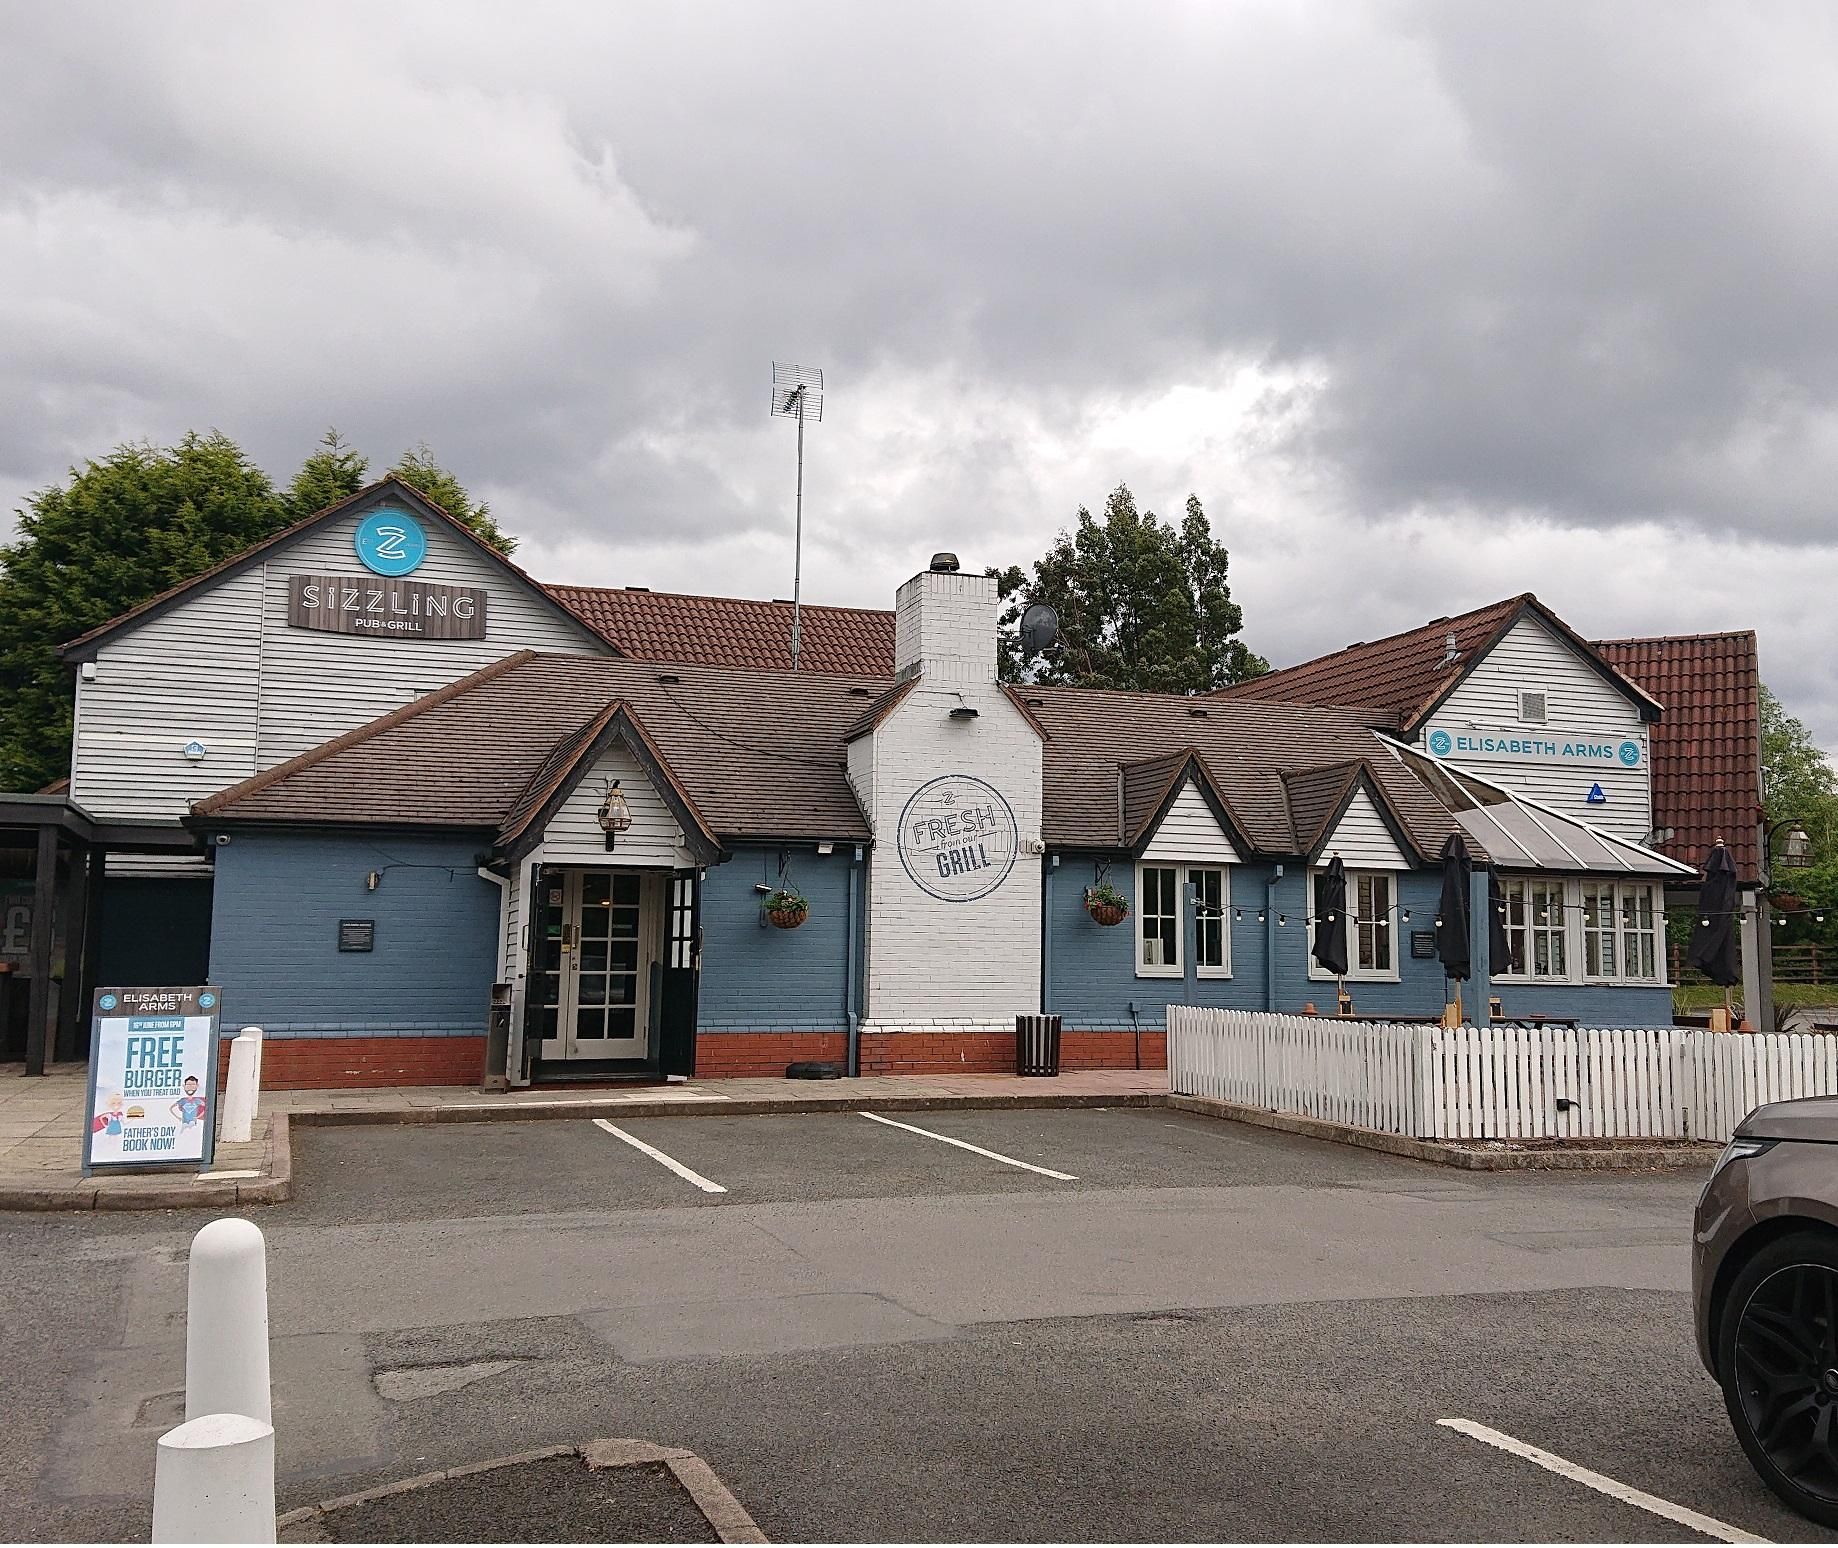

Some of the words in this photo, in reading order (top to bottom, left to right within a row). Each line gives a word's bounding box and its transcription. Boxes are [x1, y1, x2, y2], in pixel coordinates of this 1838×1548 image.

[1456, 737, 1556, 756] ELISABETH
[1562, 743, 1613, 759] ARMS
[912, 805, 996, 845] FRESH
[941, 839, 961, 850] from
[962, 834, 978, 844] our
[936, 843, 992, 878] GRILL
[123, 993, 193, 1003] ELISABETH
[138, 1002, 176, 1011] ARMS
[125, 1036, 185, 1069] FREE
[123, 1069, 182, 1089] BURGER
[123, 1089, 140, 1098] WHEN
[140, 1089, 152, 1097] YOU
[152, 1088, 169, 1096] TREAT
[169, 1088, 181, 1096] DAD
[123, 1127, 159, 1138] FATHER'S
[160, 1126, 176, 1137] DAY
[122, 1139, 148, 1152] BOOK
[150, 1137, 176, 1150] NOW!
